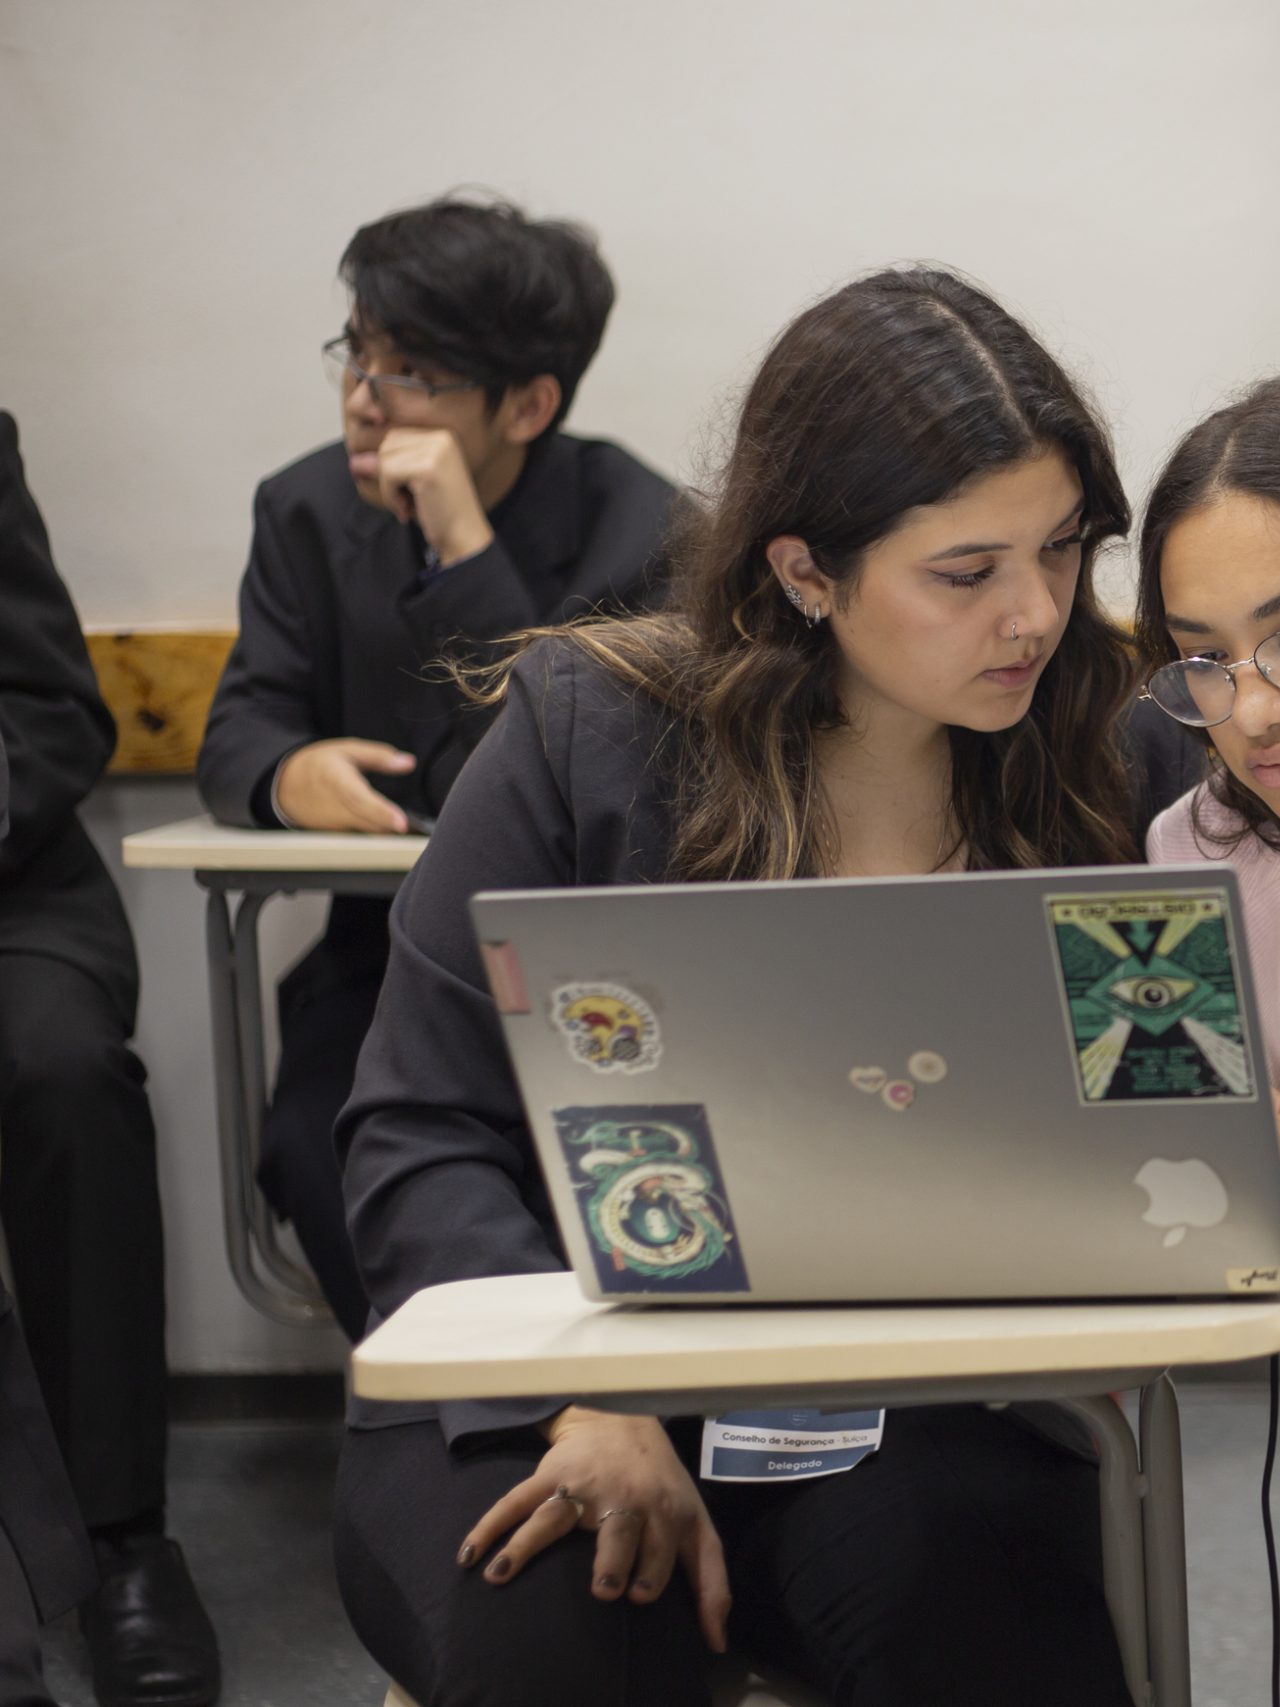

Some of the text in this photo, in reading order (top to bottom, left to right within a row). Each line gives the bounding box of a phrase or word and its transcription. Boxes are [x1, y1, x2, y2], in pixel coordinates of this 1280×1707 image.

[722, 1432, 767, 1445] Conselho
[768, 1436, 781, 1445] de
[783, 1436, 834, 1447] Segurança
[768, 1459, 822, 1471] Delegado
